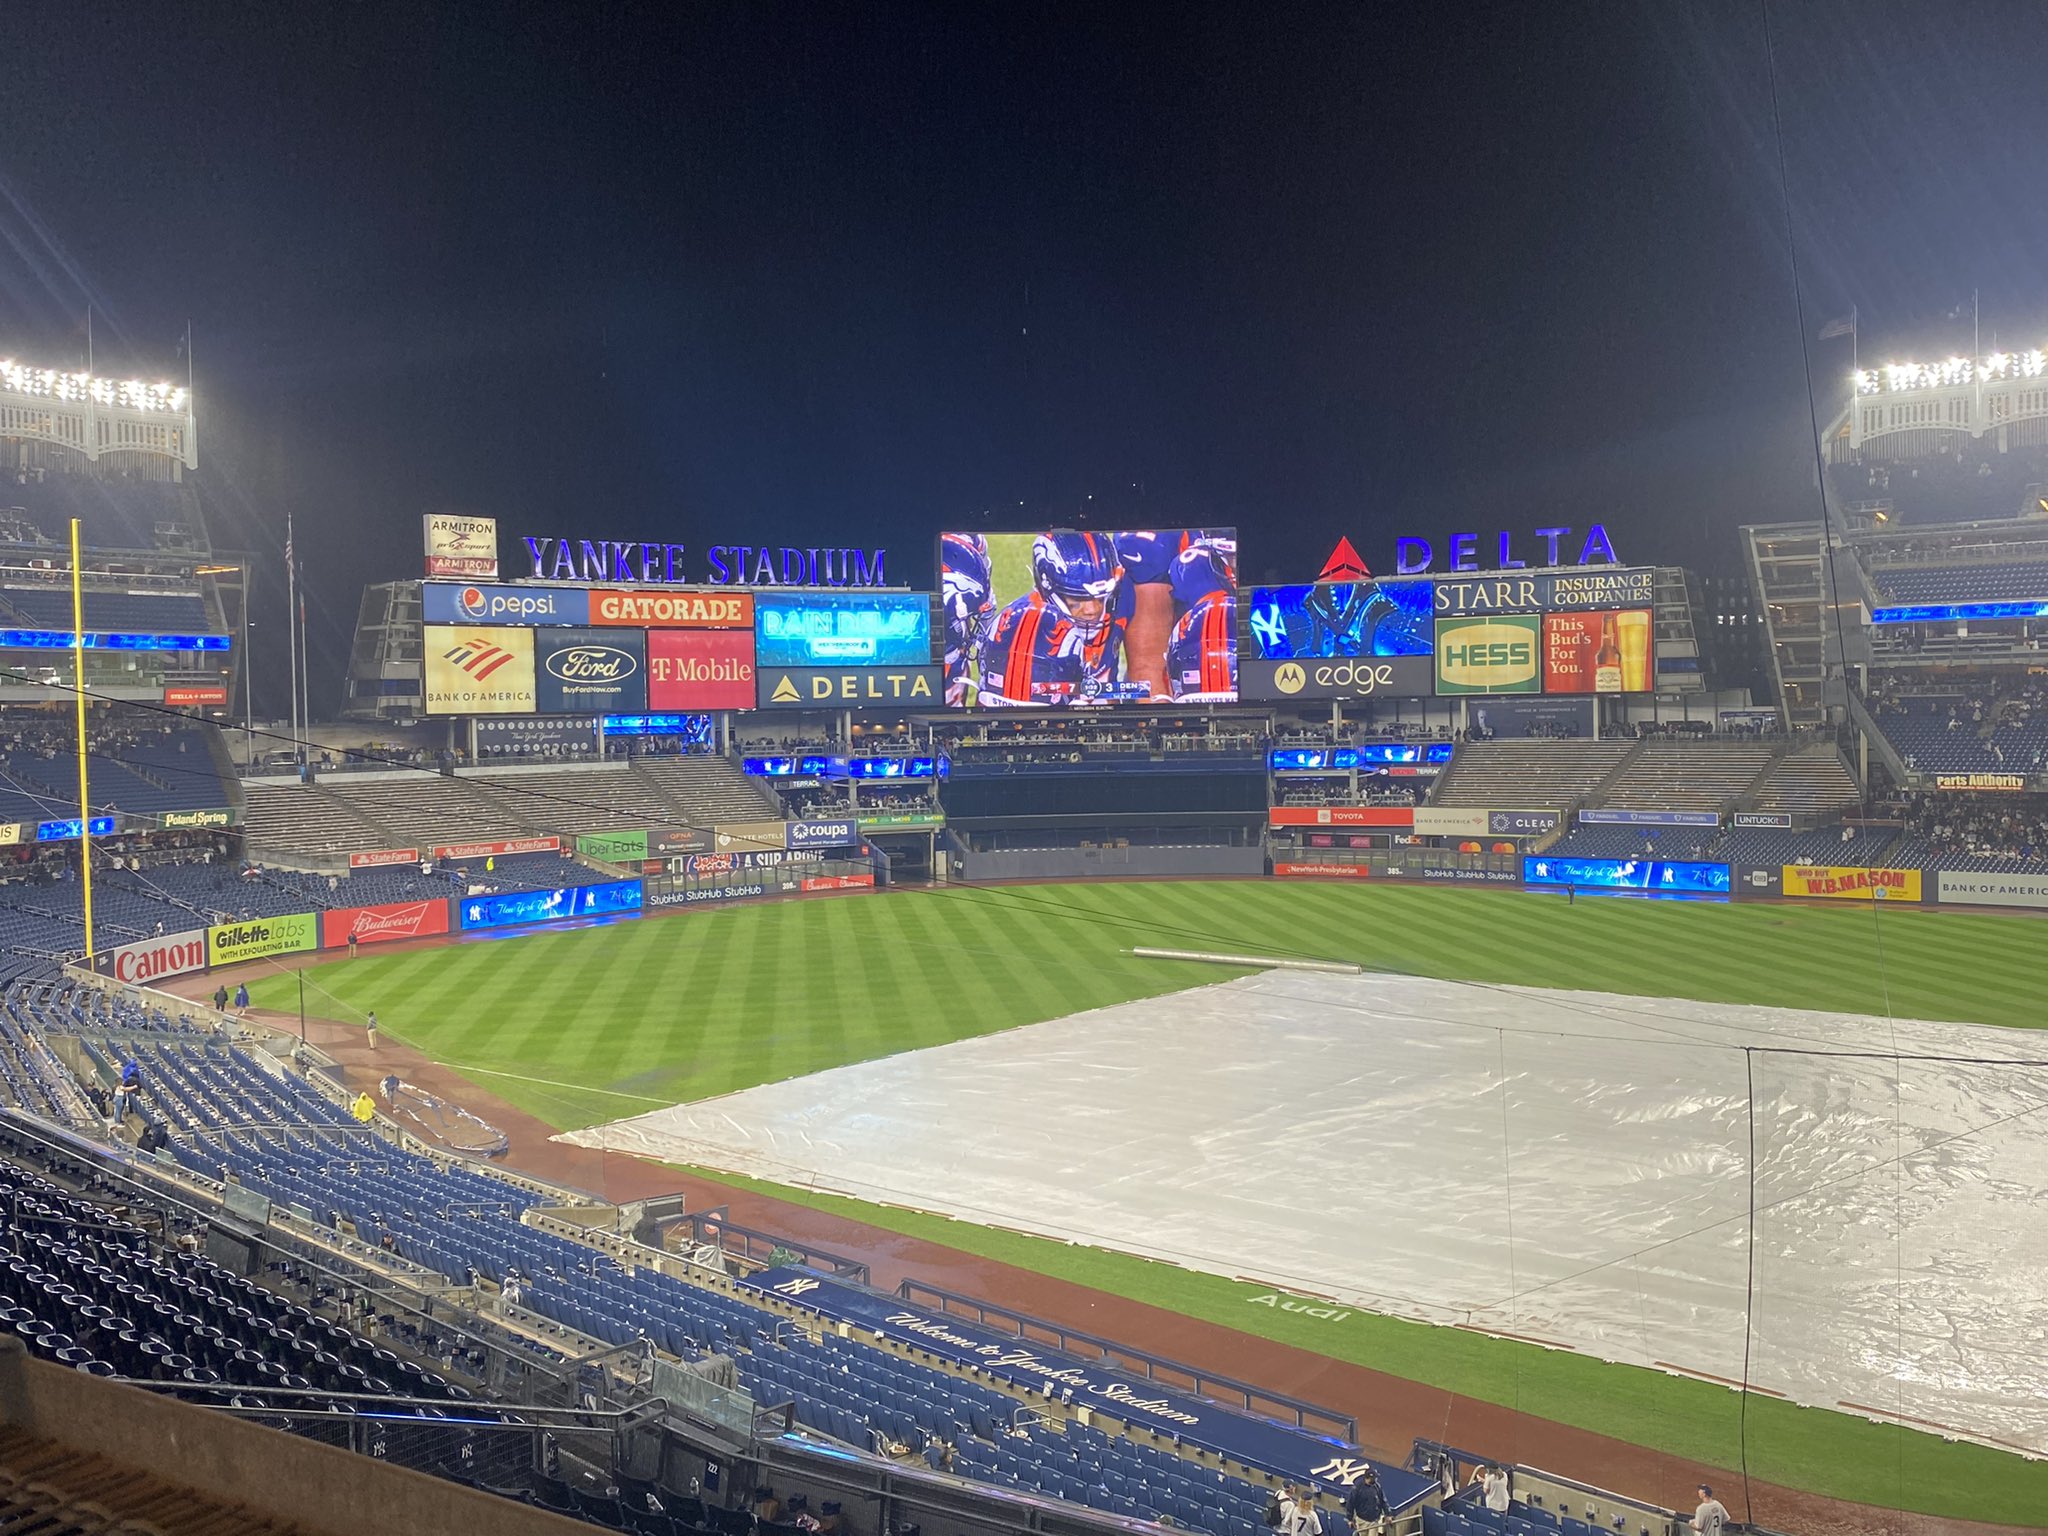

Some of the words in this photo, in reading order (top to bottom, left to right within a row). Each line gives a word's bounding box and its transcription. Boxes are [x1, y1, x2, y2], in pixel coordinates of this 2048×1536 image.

[432, 521, 492, 533] ARMITRON
[1396, 524, 1618, 574] DELTA
[436, 559, 490, 570] ARMITRON
[522, 536, 685, 584] YANKEE
[708, 545, 886, 586] STADIUM
[1555, 574, 1652, 591] INSURANCE
[1435, 581, 1541, 610] STARR
[1555, 588, 1652, 605] COMPANIES
[492, 595, 554, 617] pepsi
[601, 597, 741, 621] GATORADE
[763, 611, 833, 635] RAIN
[837, 611, 921, 635] DELAY
[1550, 618, 1584, 632] This
[1550, 632, 1592, 645] Bud's
[1446, 643, 1529, 666] HESS
[1550, 647, 1576, 660] For
[561, 650, 621, 677] Ford
[652, 658, 671, 681] T
[676, 658, 751, 681] Mobile
[1550, 662, 1583, 673] You.
[1315, 660, 1393, 695] edge
[562, 686, 621, 694] BuyFordNow.com
[812, 675, 932, 699] DELTA
[1106, 683, 1113, 692] 3
[428, 693, 459, 702] BANK
[463, 693, 477, 701] OF
[480, 692, 531, 701] AMERICA
[1936, 775, 1967, 785] Parts
[1969, 774, 2023, 786] Authority
[165, 813, 197, 827] Poland
[198, 812, 228, 826] Spring
[1516, 819, 1554, 828] CLEAR
[810, 824, 848, 838] coupa
[1394, 835, 1422, 844] FedEx
[579, 843, 611, 855] Uber
[613, 840, 643, 853] Eats
[1424, 869, 1454, 877] StubHub
[1456, 870, 1485, 879] StubHub
[1487, 872, 1516, 880] StubHub
[650, 894, 684, 905] StubHub
[686, 890, 722, 902] StubHub
[725, 885, 761, 897] StubHub
[1942, 883, 1976, 893] BANK
[1980, 884, 1995, 893] OF
[354, 915, 420, 932] Budweiser
[216, 926, 270, 949] Gillette
[220, 950, 239, 961] WITH
[284, 940, 301, 949] BAR
[116, 940, 203, 983] Canon
[885, 1312, 978, 1350] Welcome
[985, 1348, 1089, 1387] Yankee
[1088, 1382, 1199, 1426] Stadium
[1298, 1516, 1307, 1533] 7
